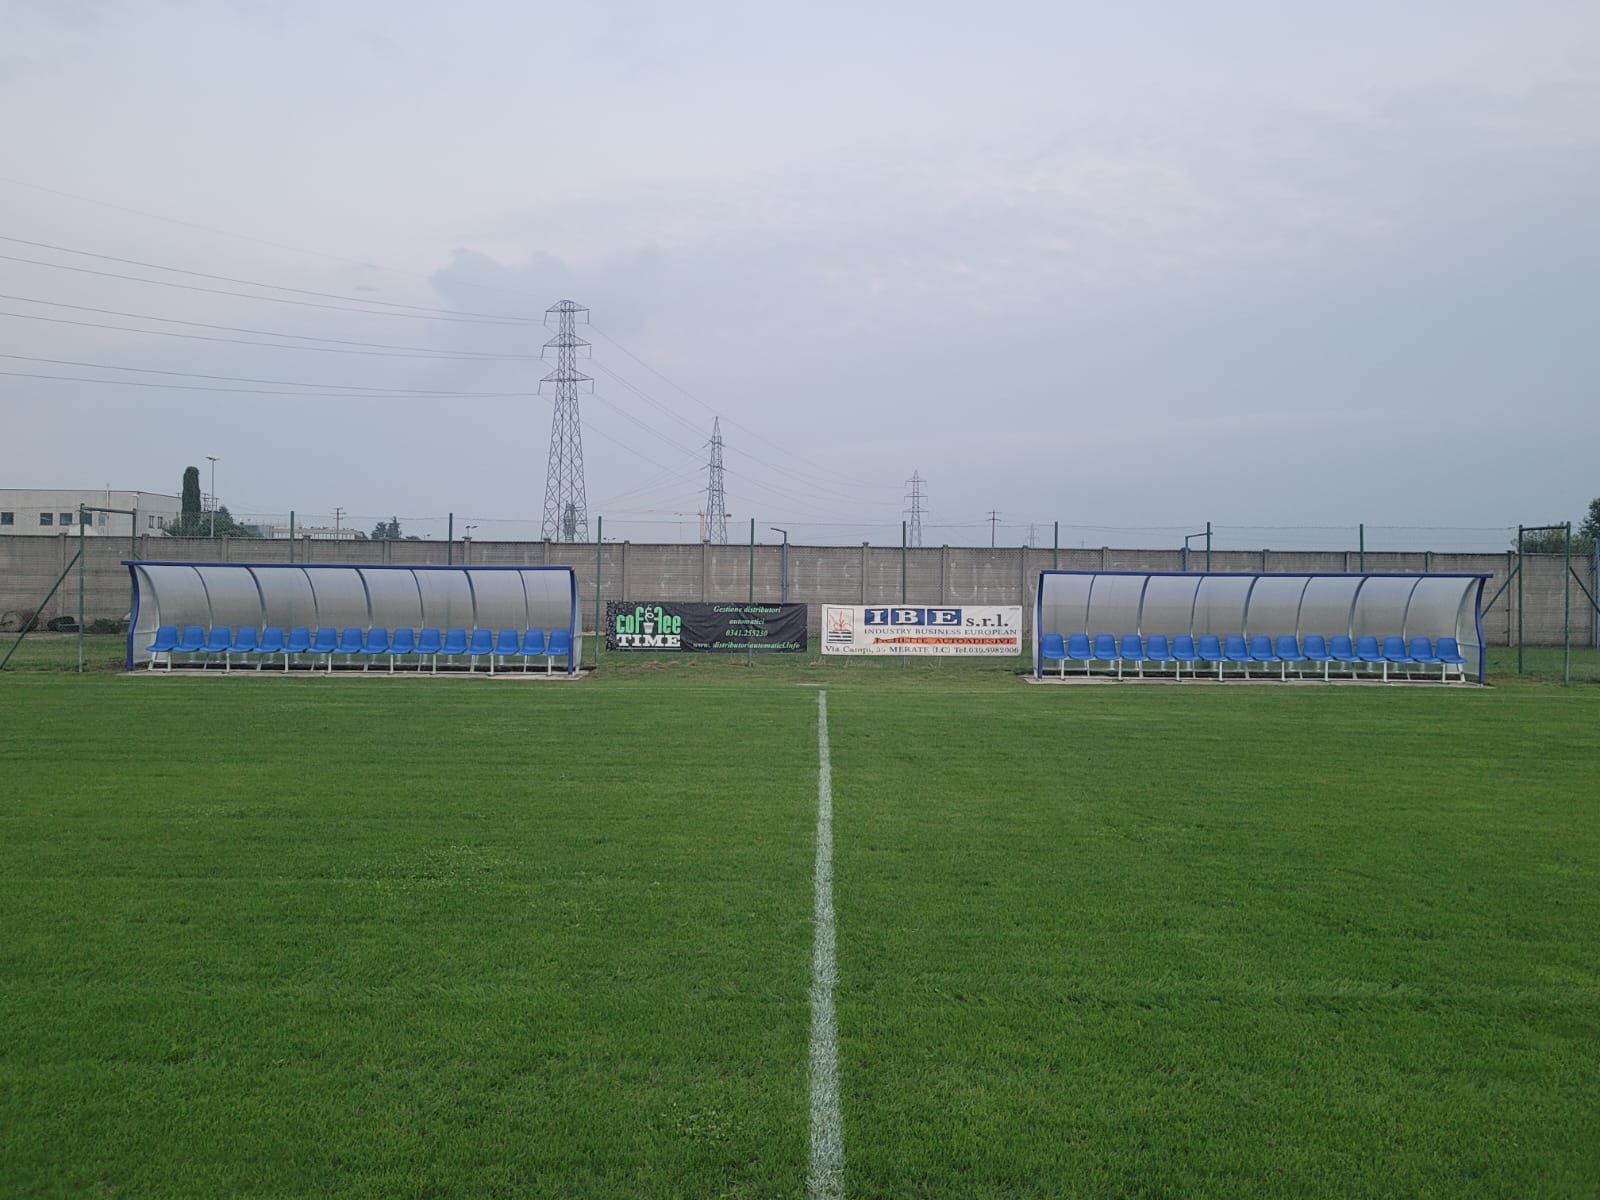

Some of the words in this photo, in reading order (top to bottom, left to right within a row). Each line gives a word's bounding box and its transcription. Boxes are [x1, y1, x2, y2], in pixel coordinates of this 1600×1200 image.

[713, 605, 742, 613] Gestione
[743, 605, 782, 613] distributori
[615, 606, 681, 634] coffee
[965, 613, 1009, 627] s.r.l.
[915, 628, 962, 636] BUSINESS
[964, 628, 1017, 636] EUROPEAN
[616, 634, 681, 647] TIME
[934, 637, 1013, 645] AUTOADESIVE
[825, 645, 840, 653] Via
